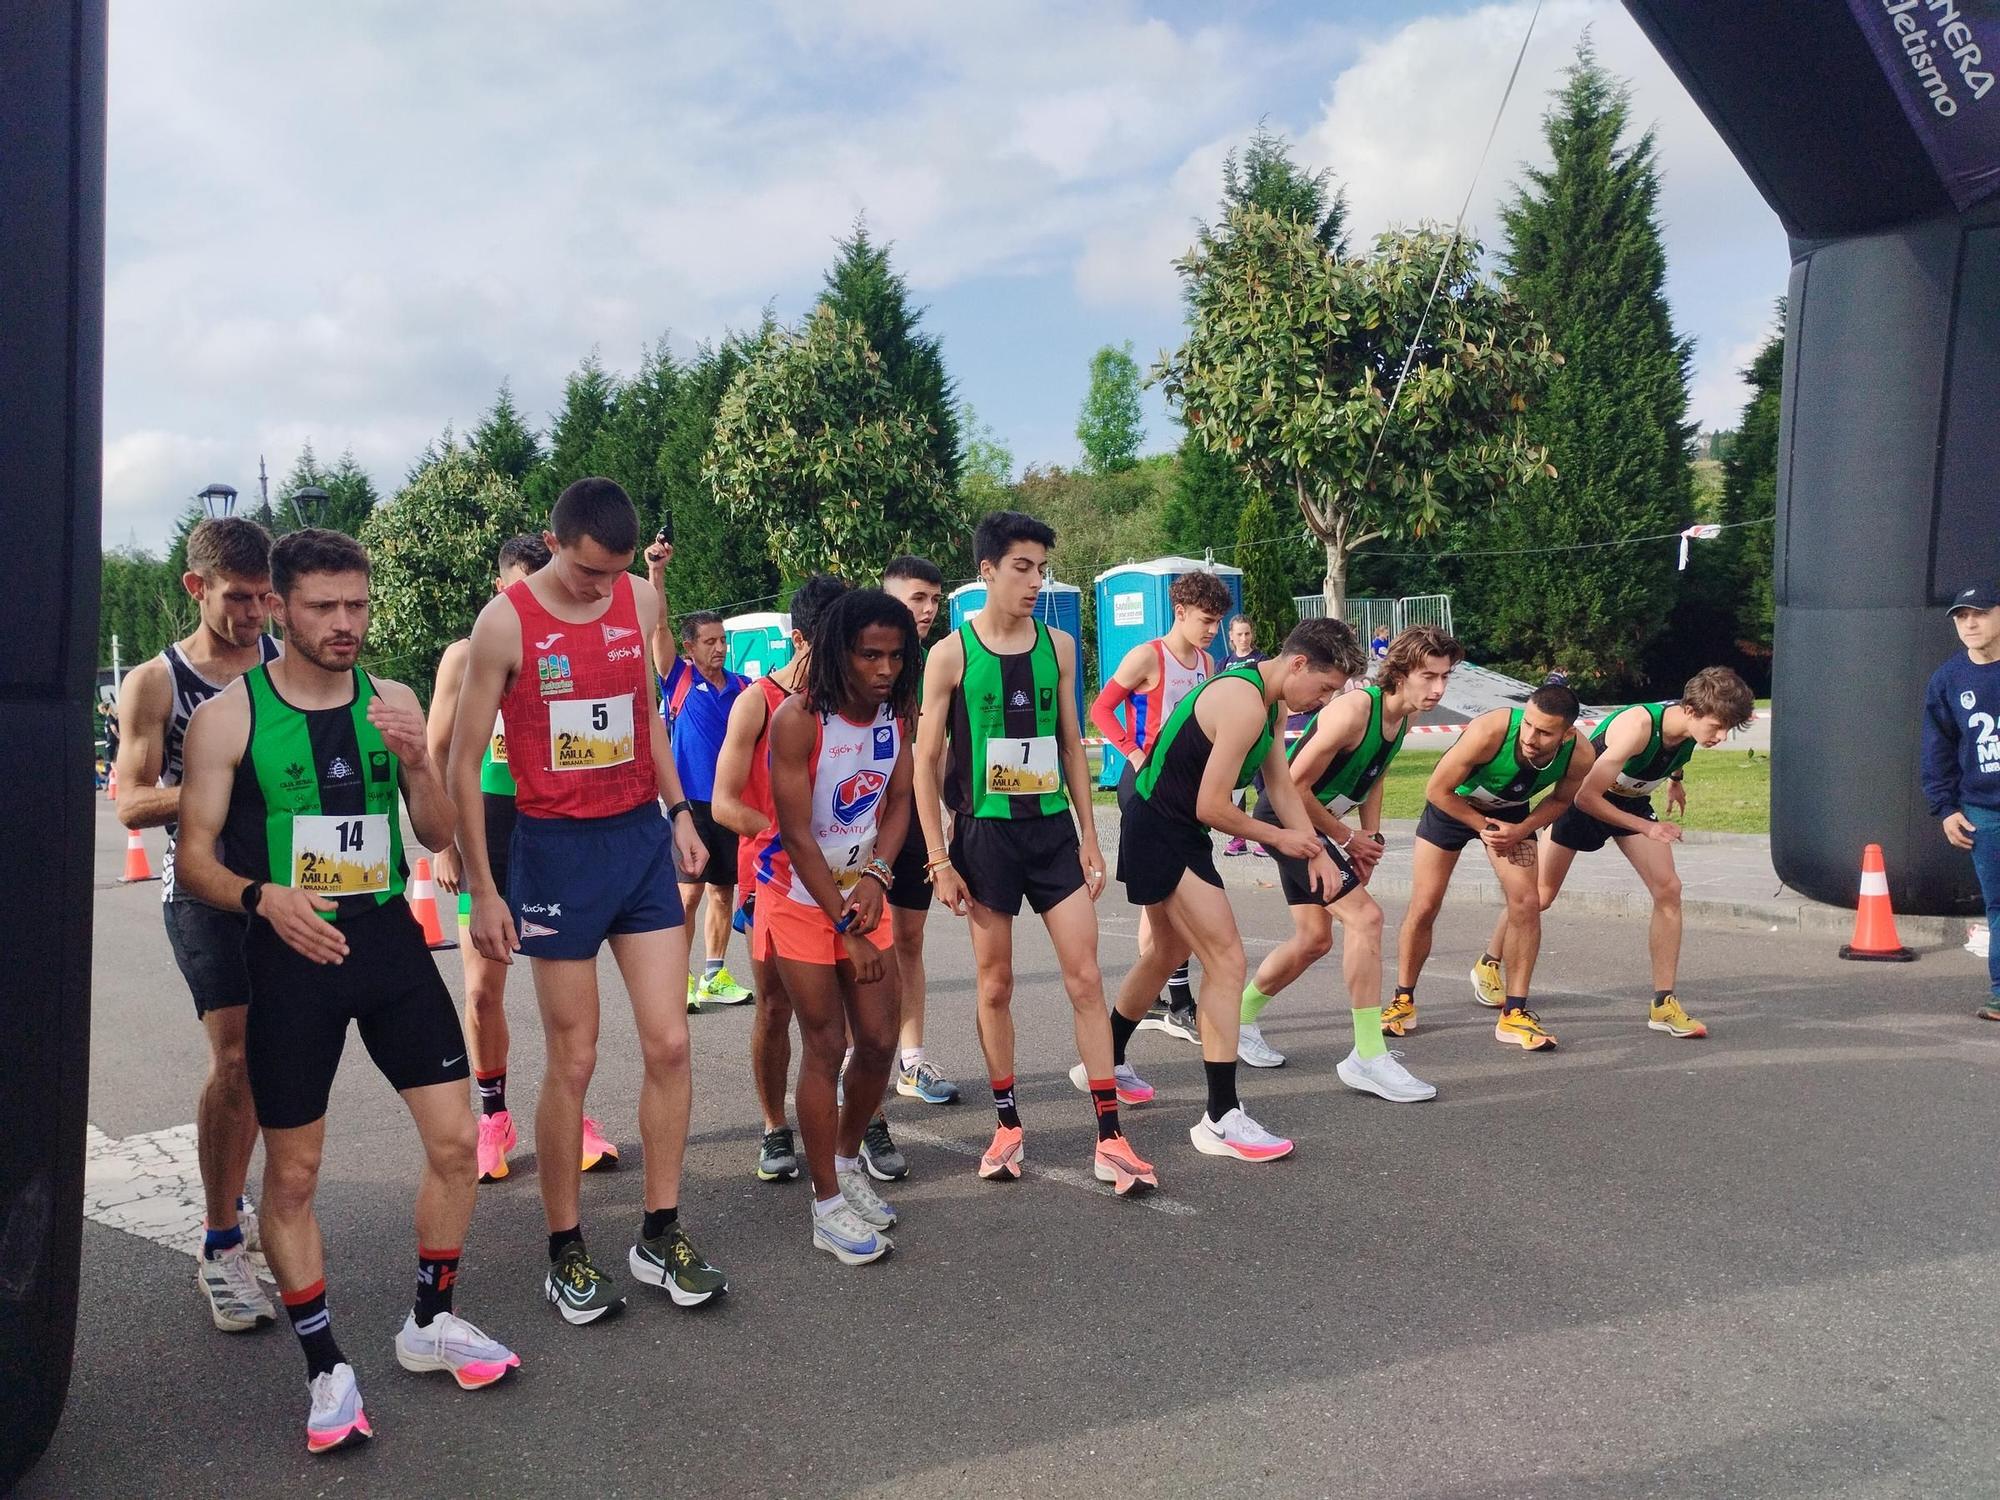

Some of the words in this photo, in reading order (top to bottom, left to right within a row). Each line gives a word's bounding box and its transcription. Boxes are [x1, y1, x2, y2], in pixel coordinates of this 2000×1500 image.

[1926, 0, 1995, 100] NERA
[592, 703, 609, 731] 5
[1968, 711, 2000, 744] 2
[559, 749, 594, 760] MILLA
[1021, 741, 1030, 765] 7
[992, 779, 1020, 787] MILLA
[335, 820, 364, 852] 14
[846, 844, 860, 867] 2
[300, 872, 342, 884] MILLA
